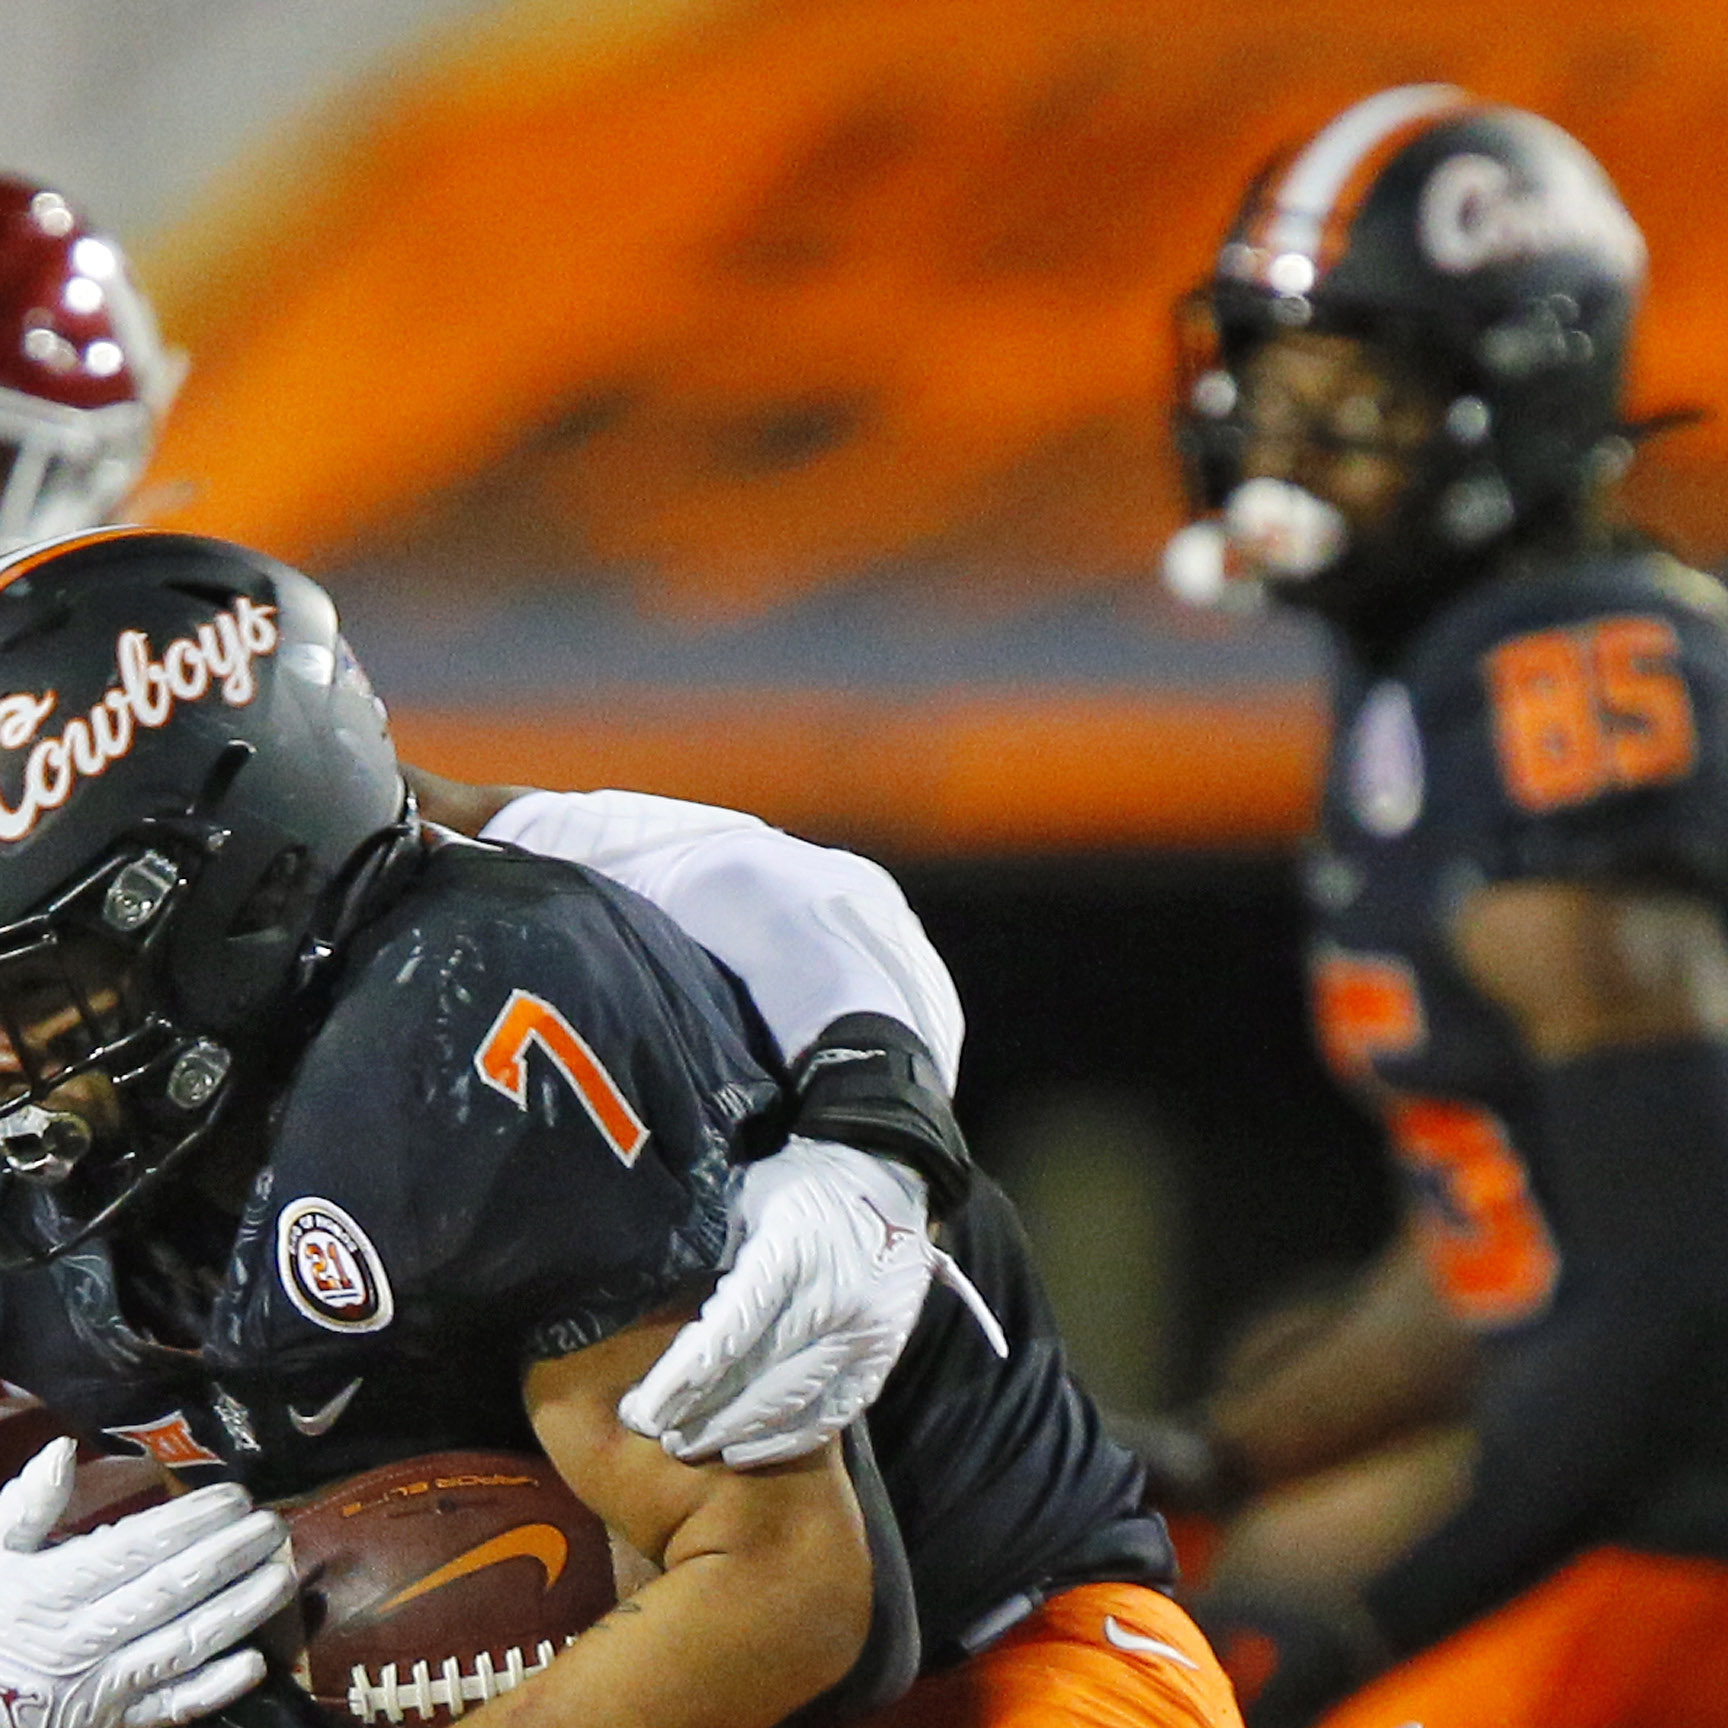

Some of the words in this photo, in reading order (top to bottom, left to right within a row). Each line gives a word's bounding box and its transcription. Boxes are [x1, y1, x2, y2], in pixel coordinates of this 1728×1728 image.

[1482, 614, 1700, 814] 85
[473, 987, 651, 1169] 7
[305, 1242, 355, 1291] 21
